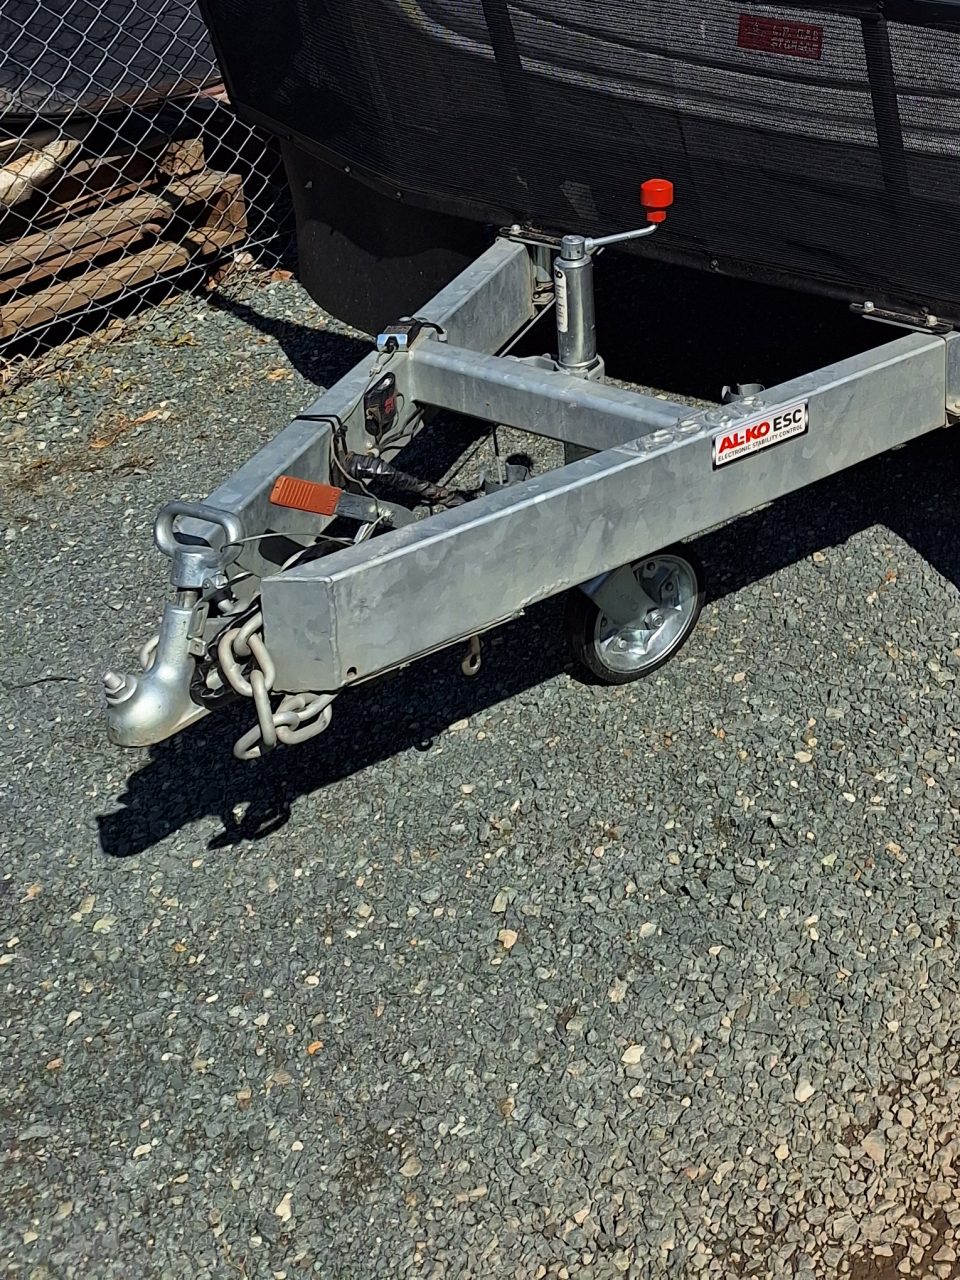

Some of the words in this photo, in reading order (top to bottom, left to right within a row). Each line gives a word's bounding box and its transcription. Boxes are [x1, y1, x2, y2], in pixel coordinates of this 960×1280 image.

[717, 444, 751, 462] ELECTRONIC
[752, 433, 778, 449] STABILITY
[778, 424, 803, 438] CONTROL
[718, 422, 770, 454] AL-KO
[773, 409, 802, 432] ESC
